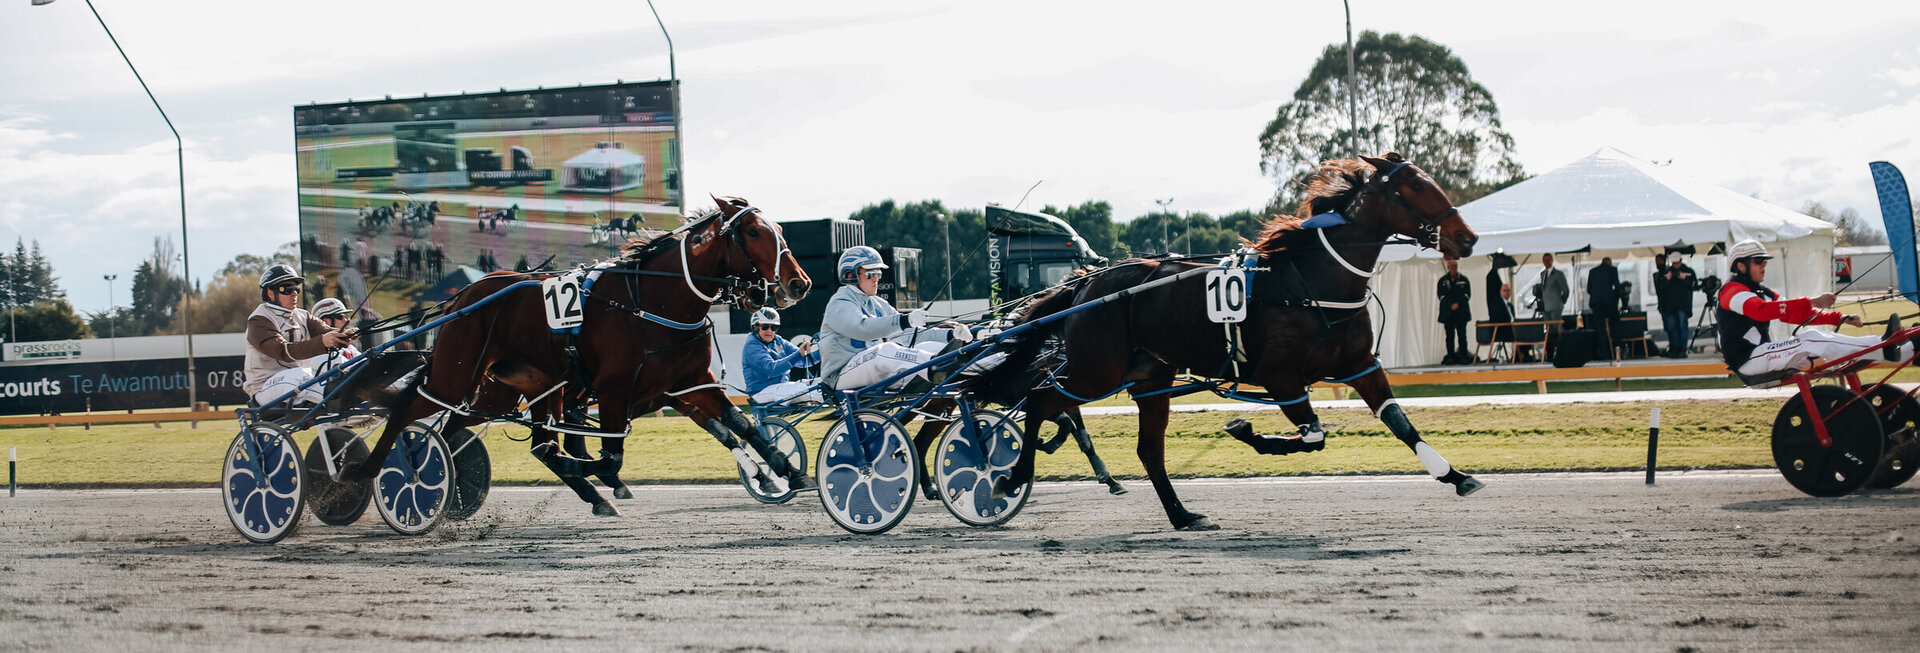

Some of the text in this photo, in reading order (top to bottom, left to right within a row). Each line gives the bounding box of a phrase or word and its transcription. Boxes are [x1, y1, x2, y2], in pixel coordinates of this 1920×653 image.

[545, 282, 581, 319] 12
[1208, 275, 1244, 311] 10
[14, 342, 81, 356] grassroos
[68, 374, 93, 394] Te
[207, 371, 228, 388] 07
